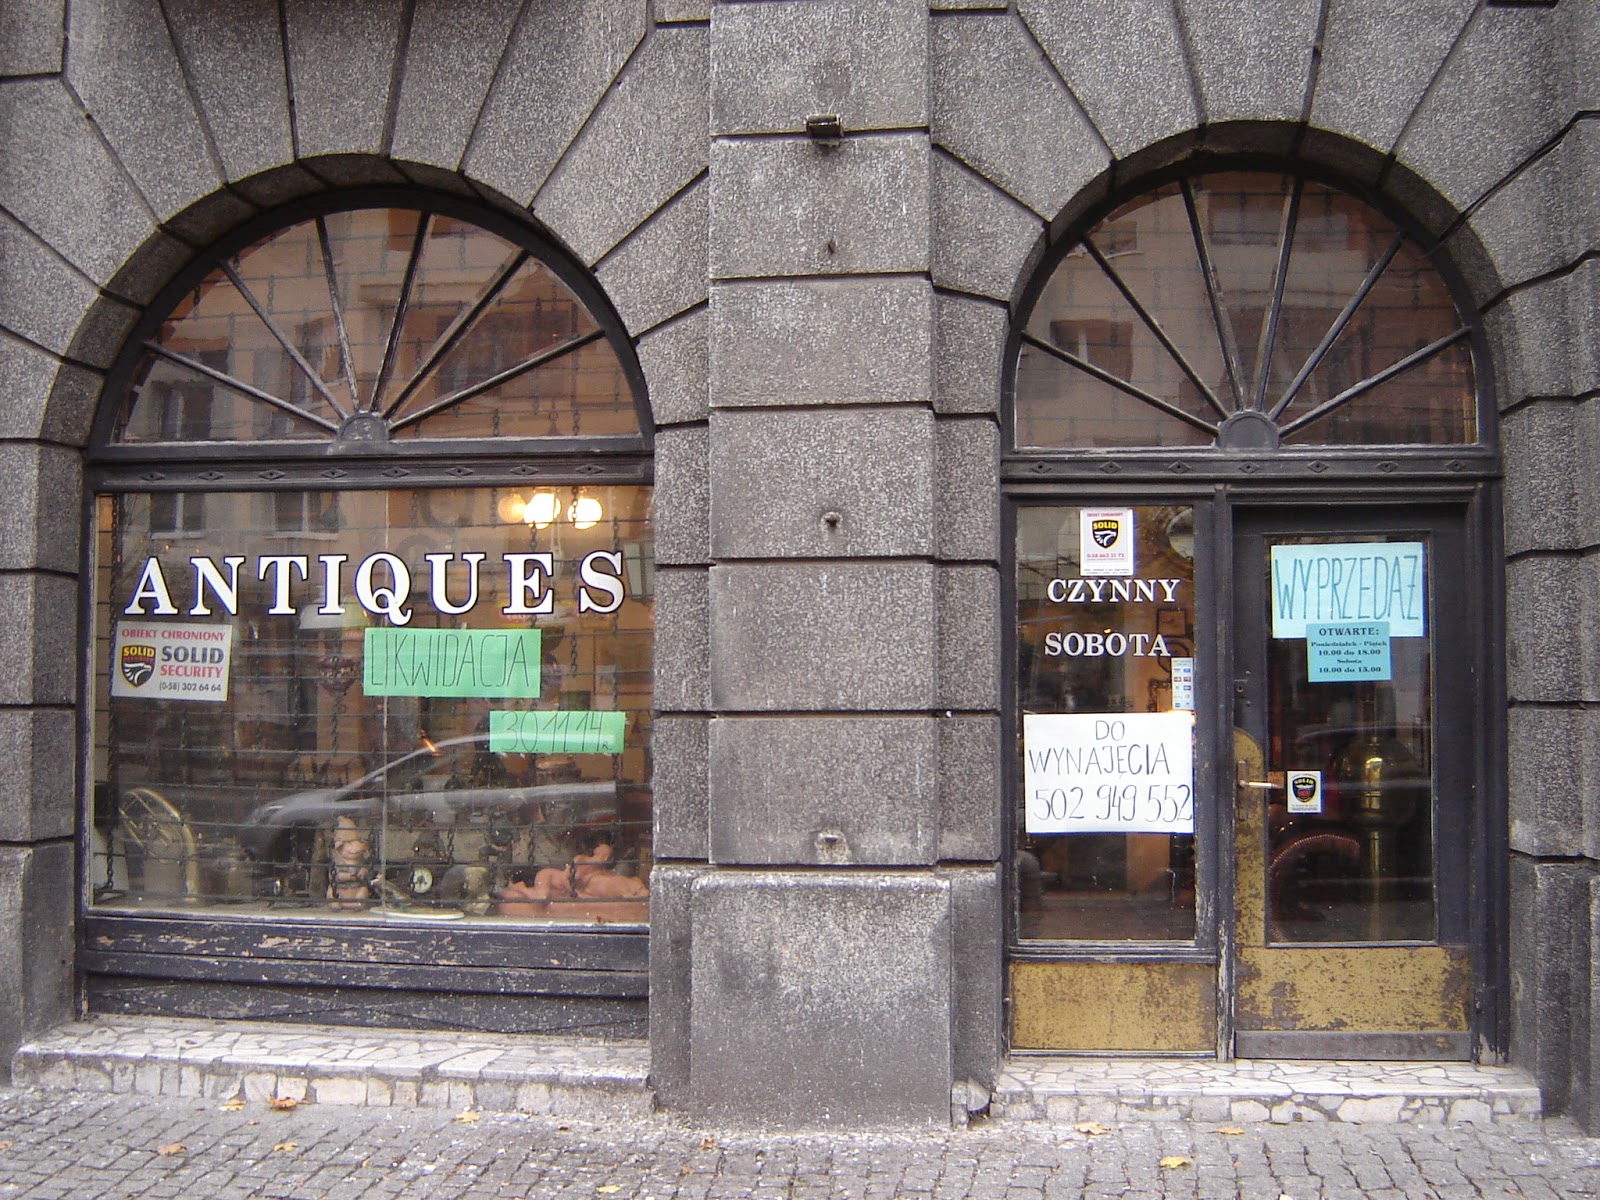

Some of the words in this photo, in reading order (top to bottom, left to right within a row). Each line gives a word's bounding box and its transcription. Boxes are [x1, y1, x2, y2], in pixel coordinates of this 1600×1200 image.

[1093, 521, 1118, 530] SOLID
[123, 551, 626, 626] ANTIQUES
[1047, 578, 1180, 602] CZYNNY
[121, 628, 158, 638] OBIEKT
[161, 630, 226, 641] CHRONIONY
[1318, 627, 1379, 636] OTWARTE:
[123, 646, 155, 657] SOLID
[1045, 632, 1171, 657] SOBOTA
[161, 645, 225, 664] SOLID
[370, 630, 529, 688] LIKWIDACJA
[160, 664, 223, 678] SECURITY
[159, 682, 180, 692] (0-58)
[182, 682, 197, 691] 302
[198, 683, 209, 692] 64
[210, 683, 221, 692] 64
[1095, 720, 1125, 742] DO
[1034, 786, 1085, 821] 502
[1096, 784, 1138, 822] 949
[1145, 784, 1193, 823] 552
